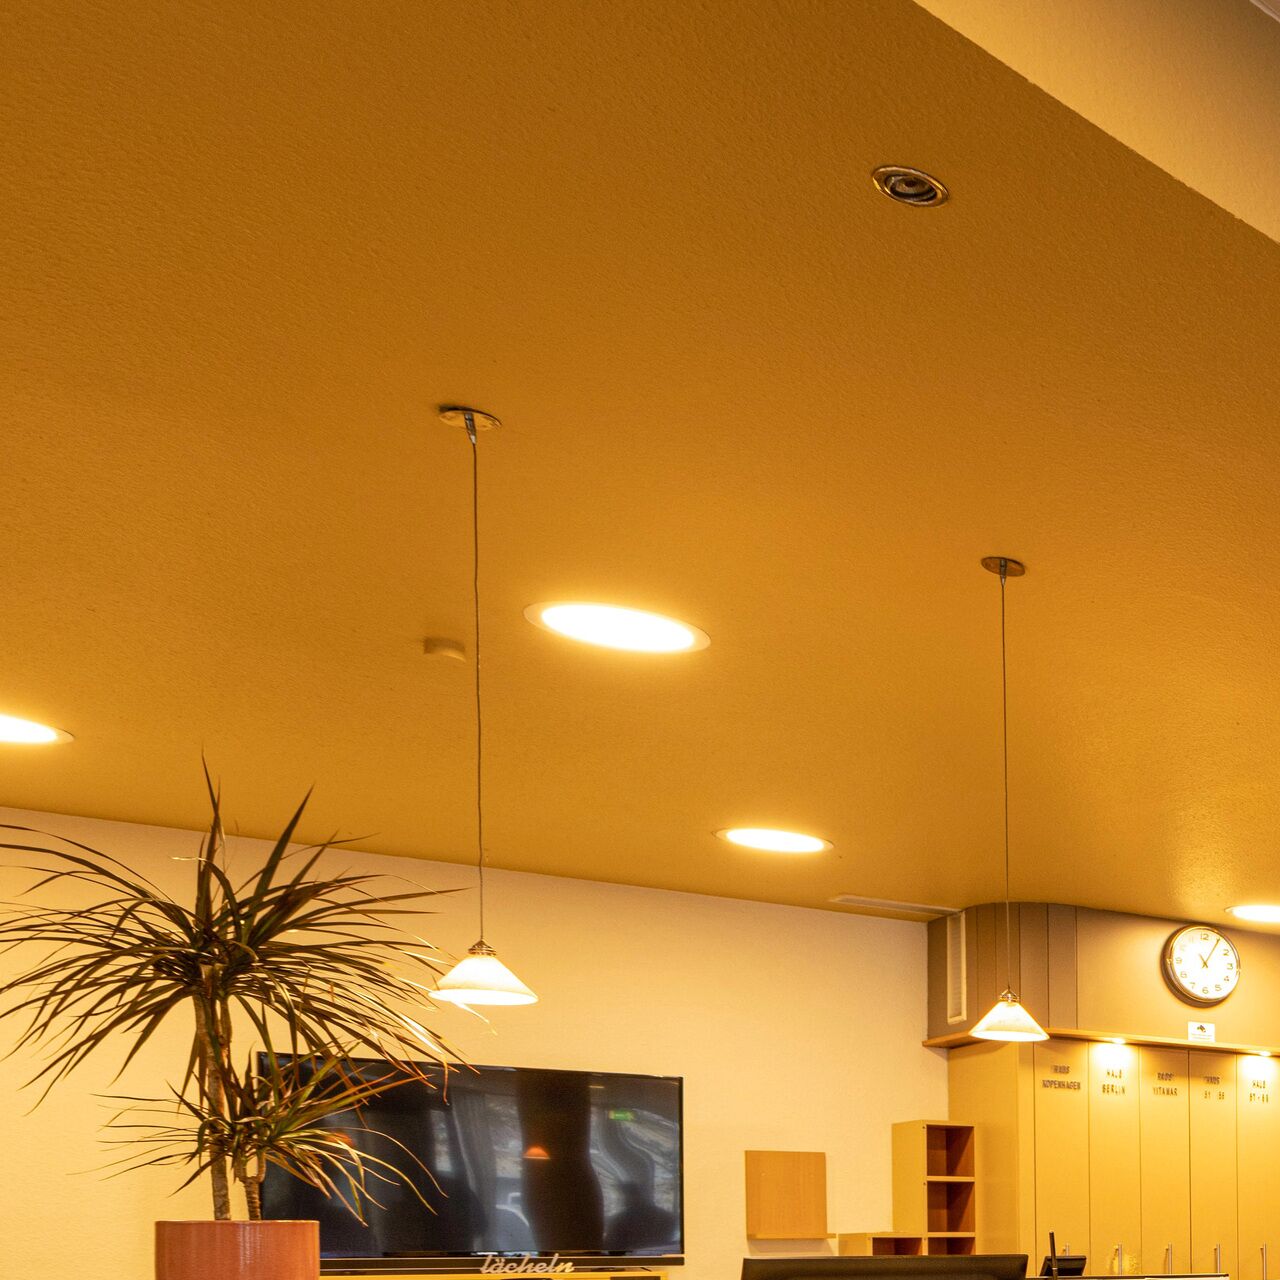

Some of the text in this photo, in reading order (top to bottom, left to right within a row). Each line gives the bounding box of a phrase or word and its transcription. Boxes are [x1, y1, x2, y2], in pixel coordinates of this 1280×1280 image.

[1199, 933, 1209, 941] 12
[1202, 986, 1209, 994] 6
[1102, 1084, 1126, 1095] BERLIN
[479, 1252, 576, 1274] lächeln
